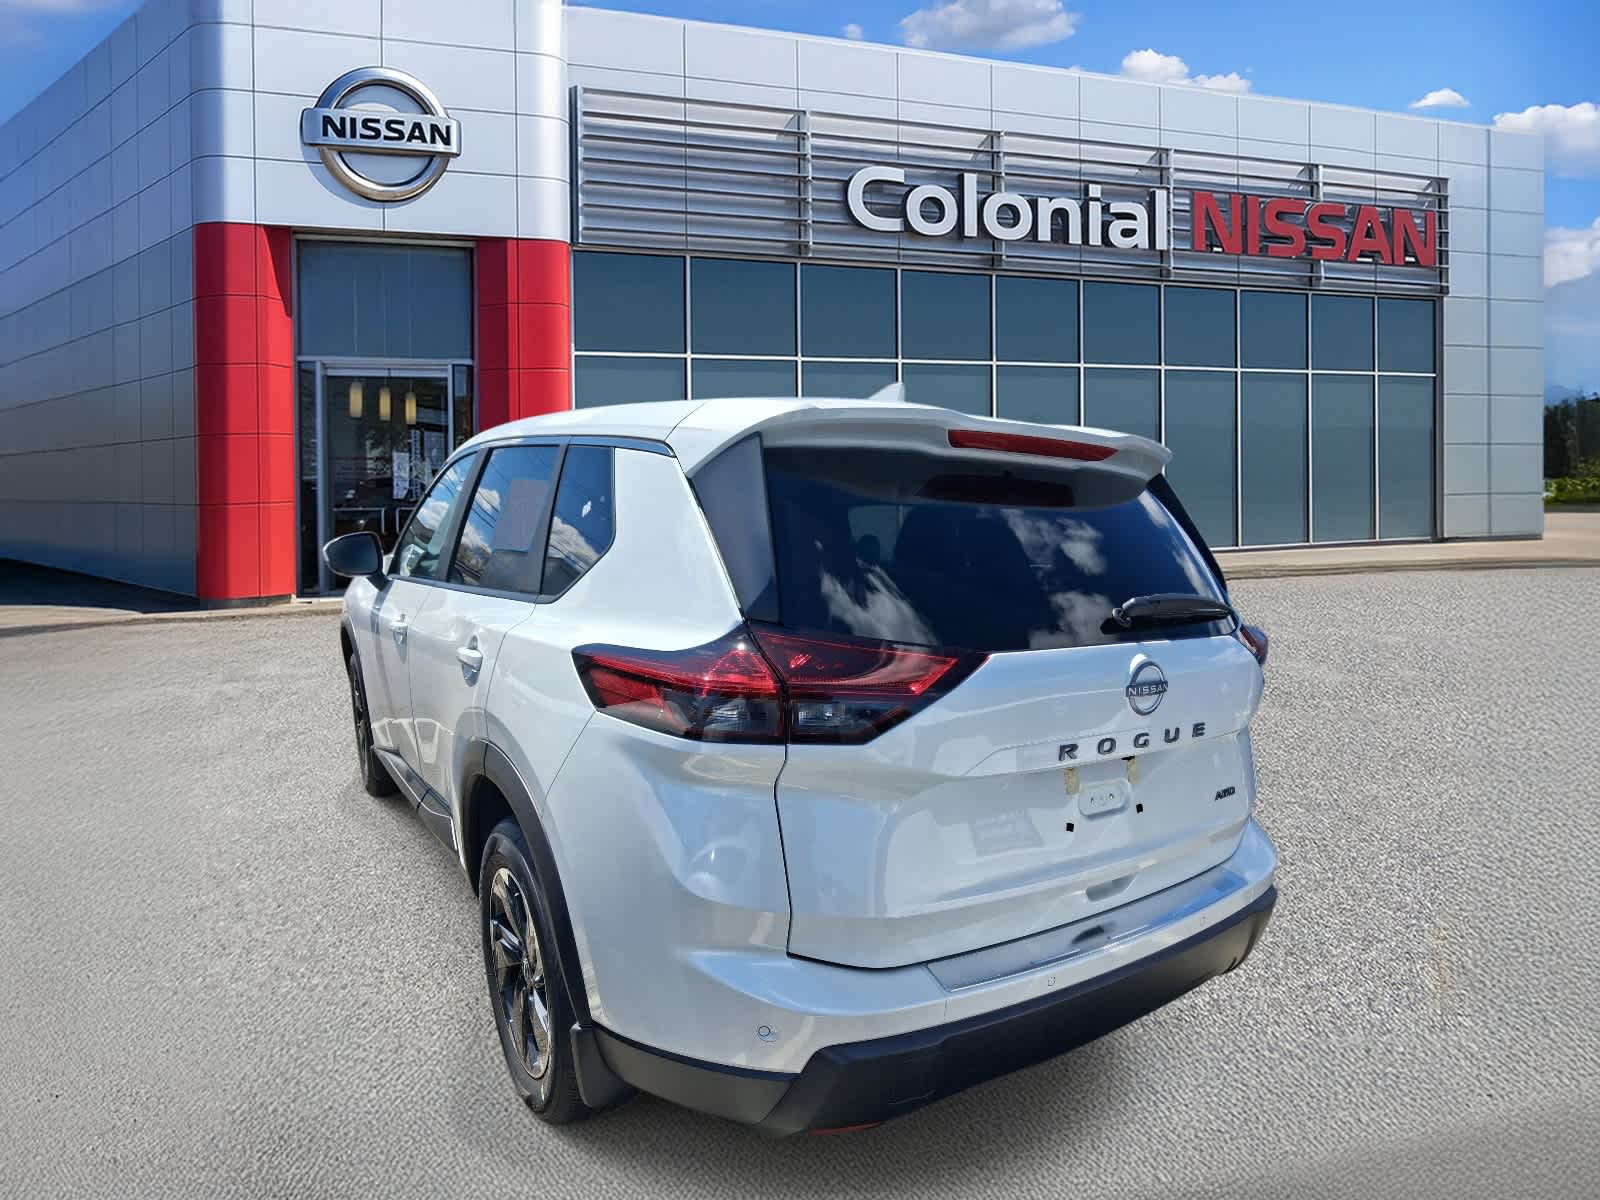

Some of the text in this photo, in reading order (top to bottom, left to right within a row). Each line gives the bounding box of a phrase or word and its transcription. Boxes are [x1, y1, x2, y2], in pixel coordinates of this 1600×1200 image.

[321, 115, 451, 146] NISSAN
[847, 165, 1437, 267] Colonial NISSAN
[1128, 682, 1168, 696] NISSAN
[1058, 722, 1206, 761] ROGUE
